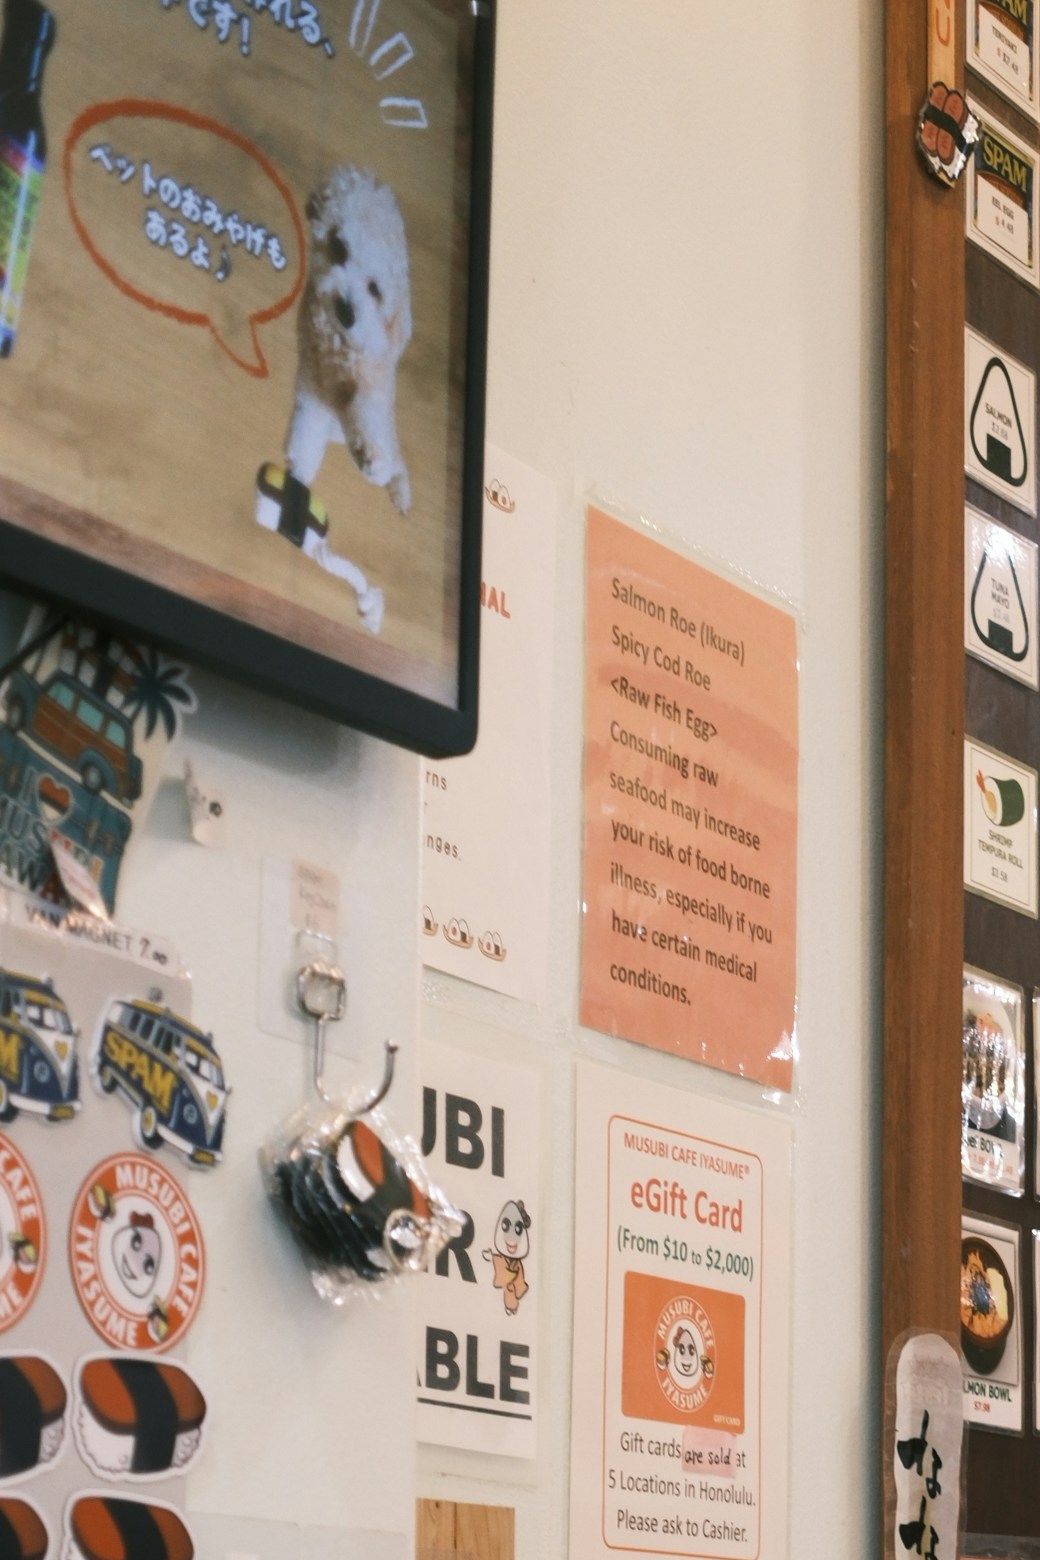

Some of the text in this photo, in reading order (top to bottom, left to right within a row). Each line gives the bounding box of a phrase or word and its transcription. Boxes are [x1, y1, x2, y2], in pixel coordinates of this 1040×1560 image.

[982, 134, 1027, 192] SPAM
[612, 577, 746, 668] Salmon Roe (Ikura)
[611, 624, 711, 692] Spicy Cod Roe
[610, 675, 719, 743] <Raw Fish Egg>
[610, 720, 719, 787] Consuming raw
[610, 771, 761, 851] seafood may increase
[988, 829, 1013, 848] SHRIMP
[611, 818, 771, 900] your risk of food borne
[977, 839, 1023, 870] TEMPURA ROLL
[610, 861, 773, 945] illness, especially if you
[611, 909, 758, 984] have certain medical
[610, 961, 691, 1006] conditions.
[105, 1030, 178, 1118] SPAM
[624, 1132, 697, 1167] MUSUBI CAFE
[630, 1178, 742, 1233] eGift Card
[114, 1163, 200, 1319] MUSUBI CAFE
[617, 1225, 754, 1282] (From $10 to $2,000)
[76, 1225, 140, 1347] IYASUME
[661, 1377, 710, 1411] IYASUME
[988, 1386, 1012, 1402] BOWL
[620, 1430, 746, 1468] Gift cards are sold at
[608, 1469, 757, 1508] 5 Locations in Honolulu.
[617, 1508, 749, 1543] Please ask to Cashier.
